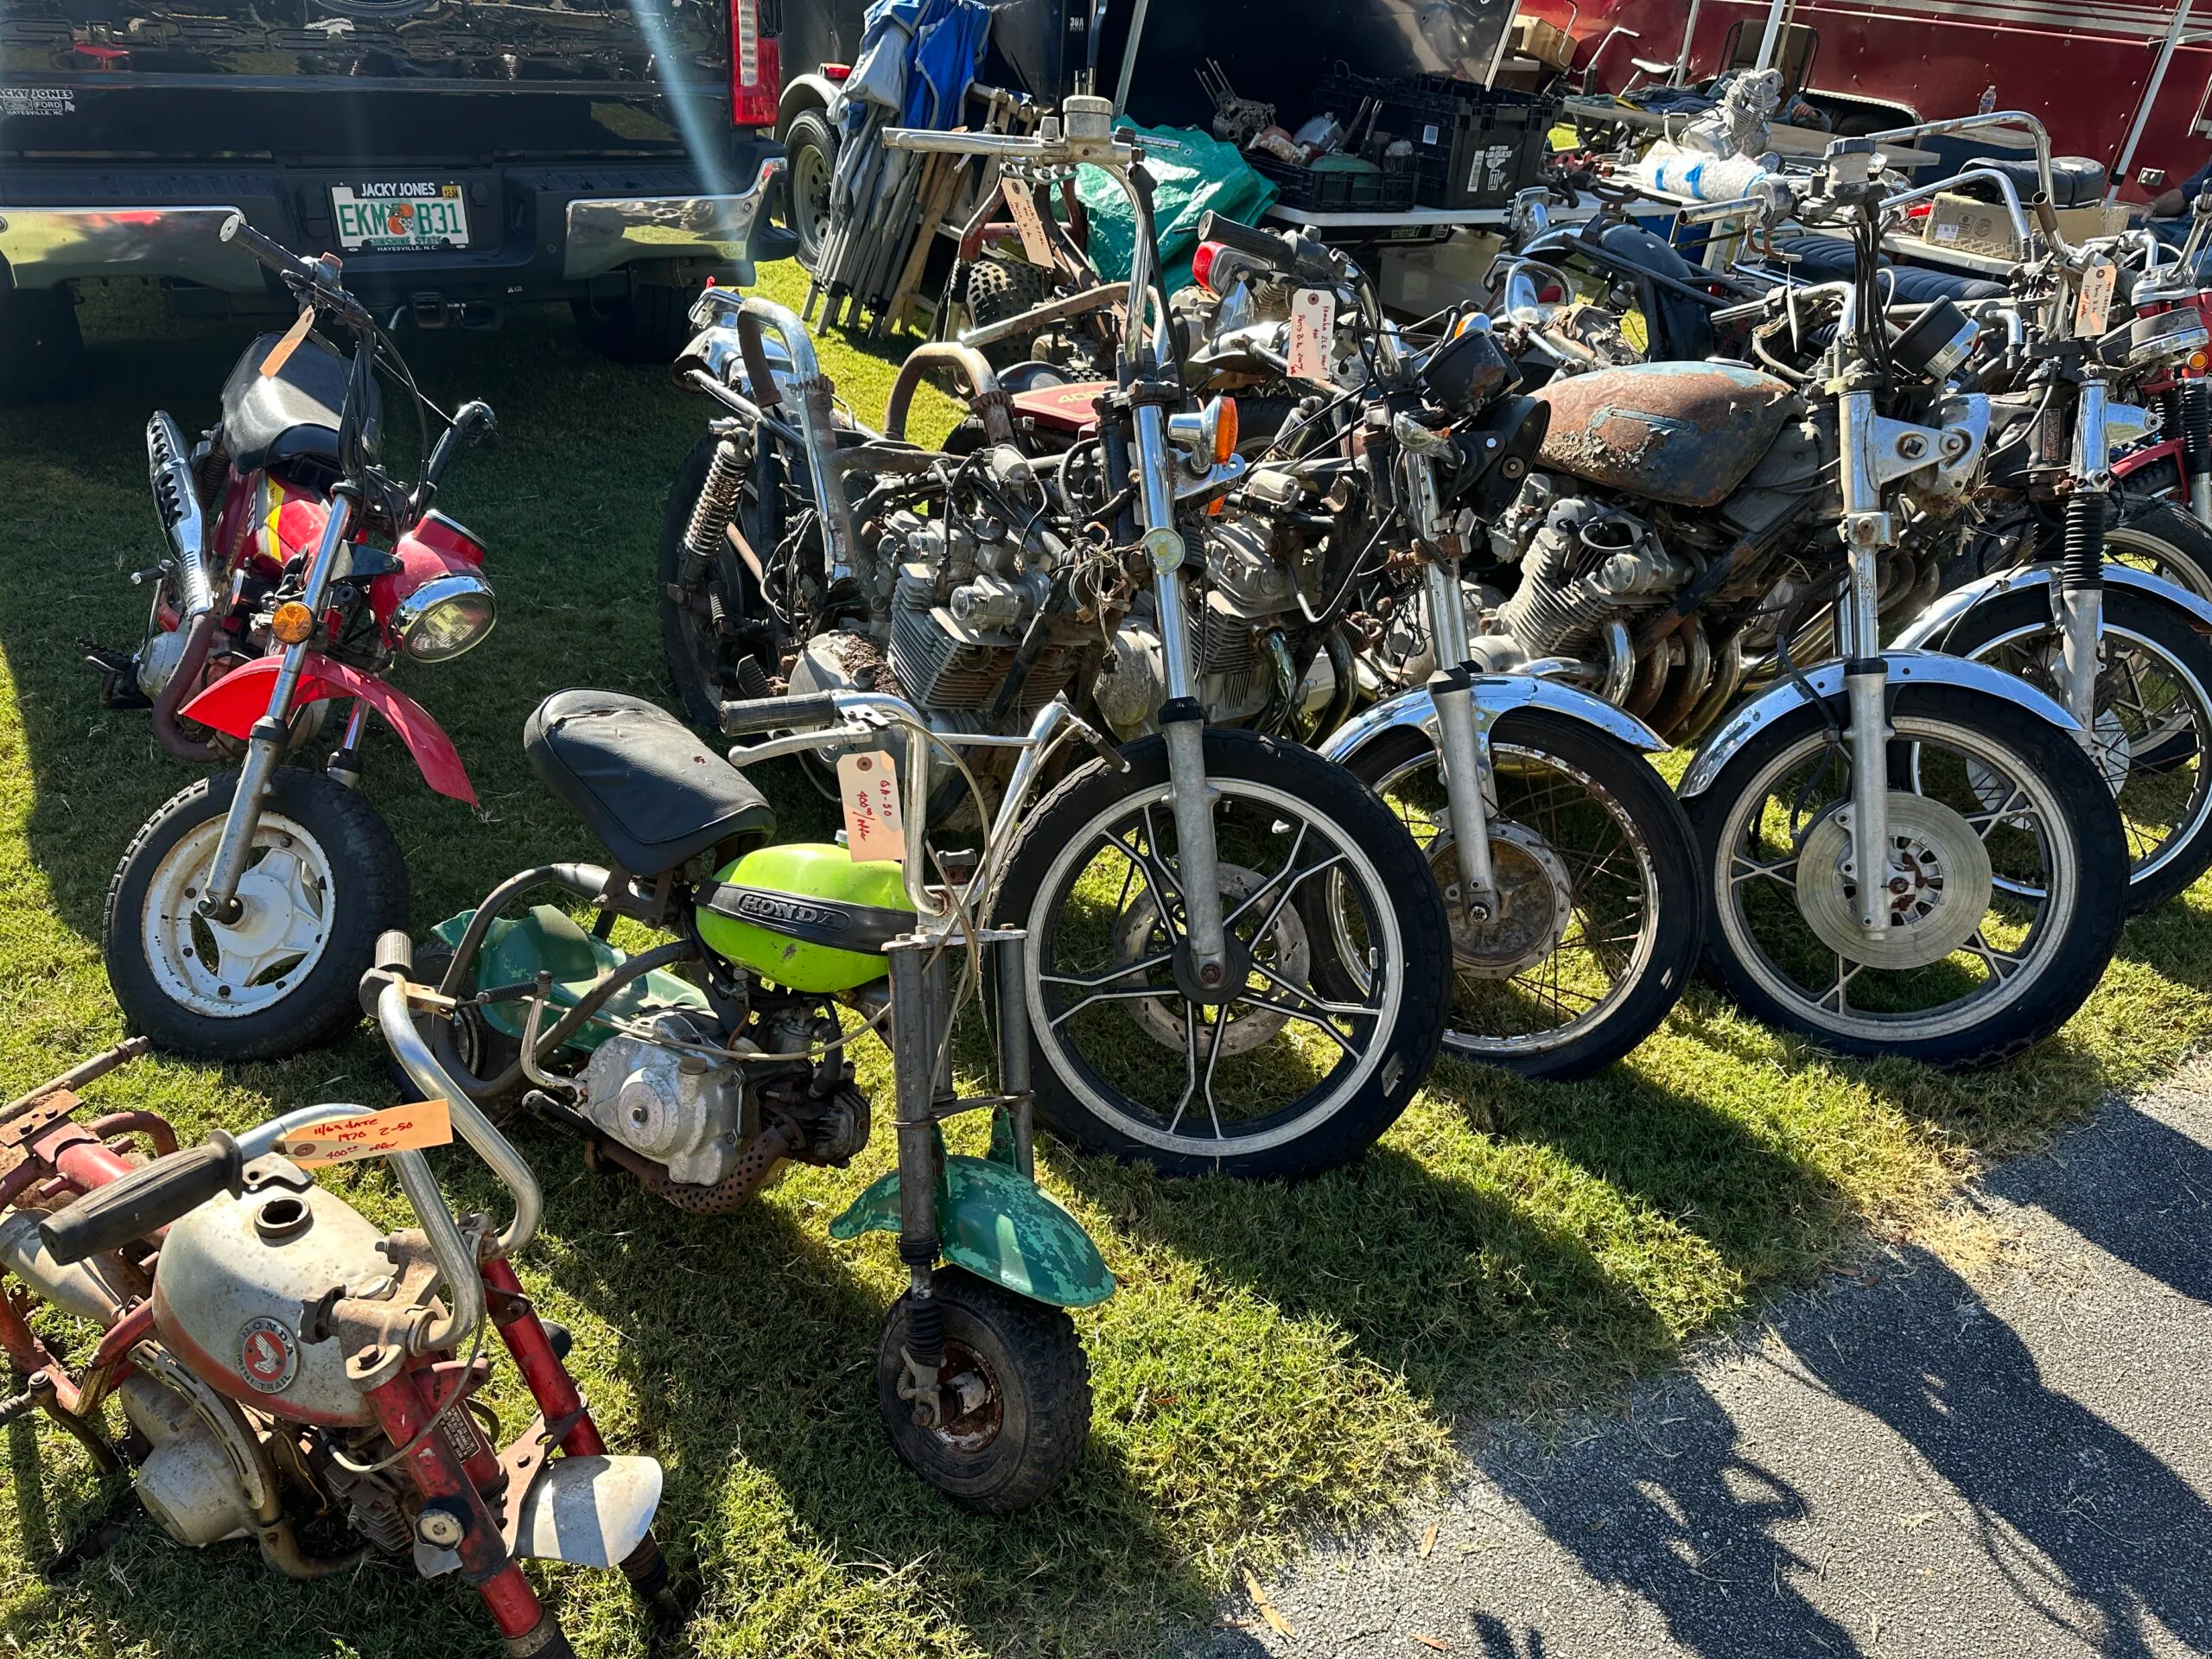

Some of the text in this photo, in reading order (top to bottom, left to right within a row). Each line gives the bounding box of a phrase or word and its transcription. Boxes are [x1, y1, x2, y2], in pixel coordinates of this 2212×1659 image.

[31, 88, 73, 99] JONES
[361, 182, 436, 197] JACKY JONES
[338, 202, 463, 237] EKM B31
[741, 895, 837, 925] HONDA
[338, 1131, 367, 1142] 1970
[241, 1321, 295, 1357] HONDA
[237, 1354, 292, 1391] MINI TRAIL
